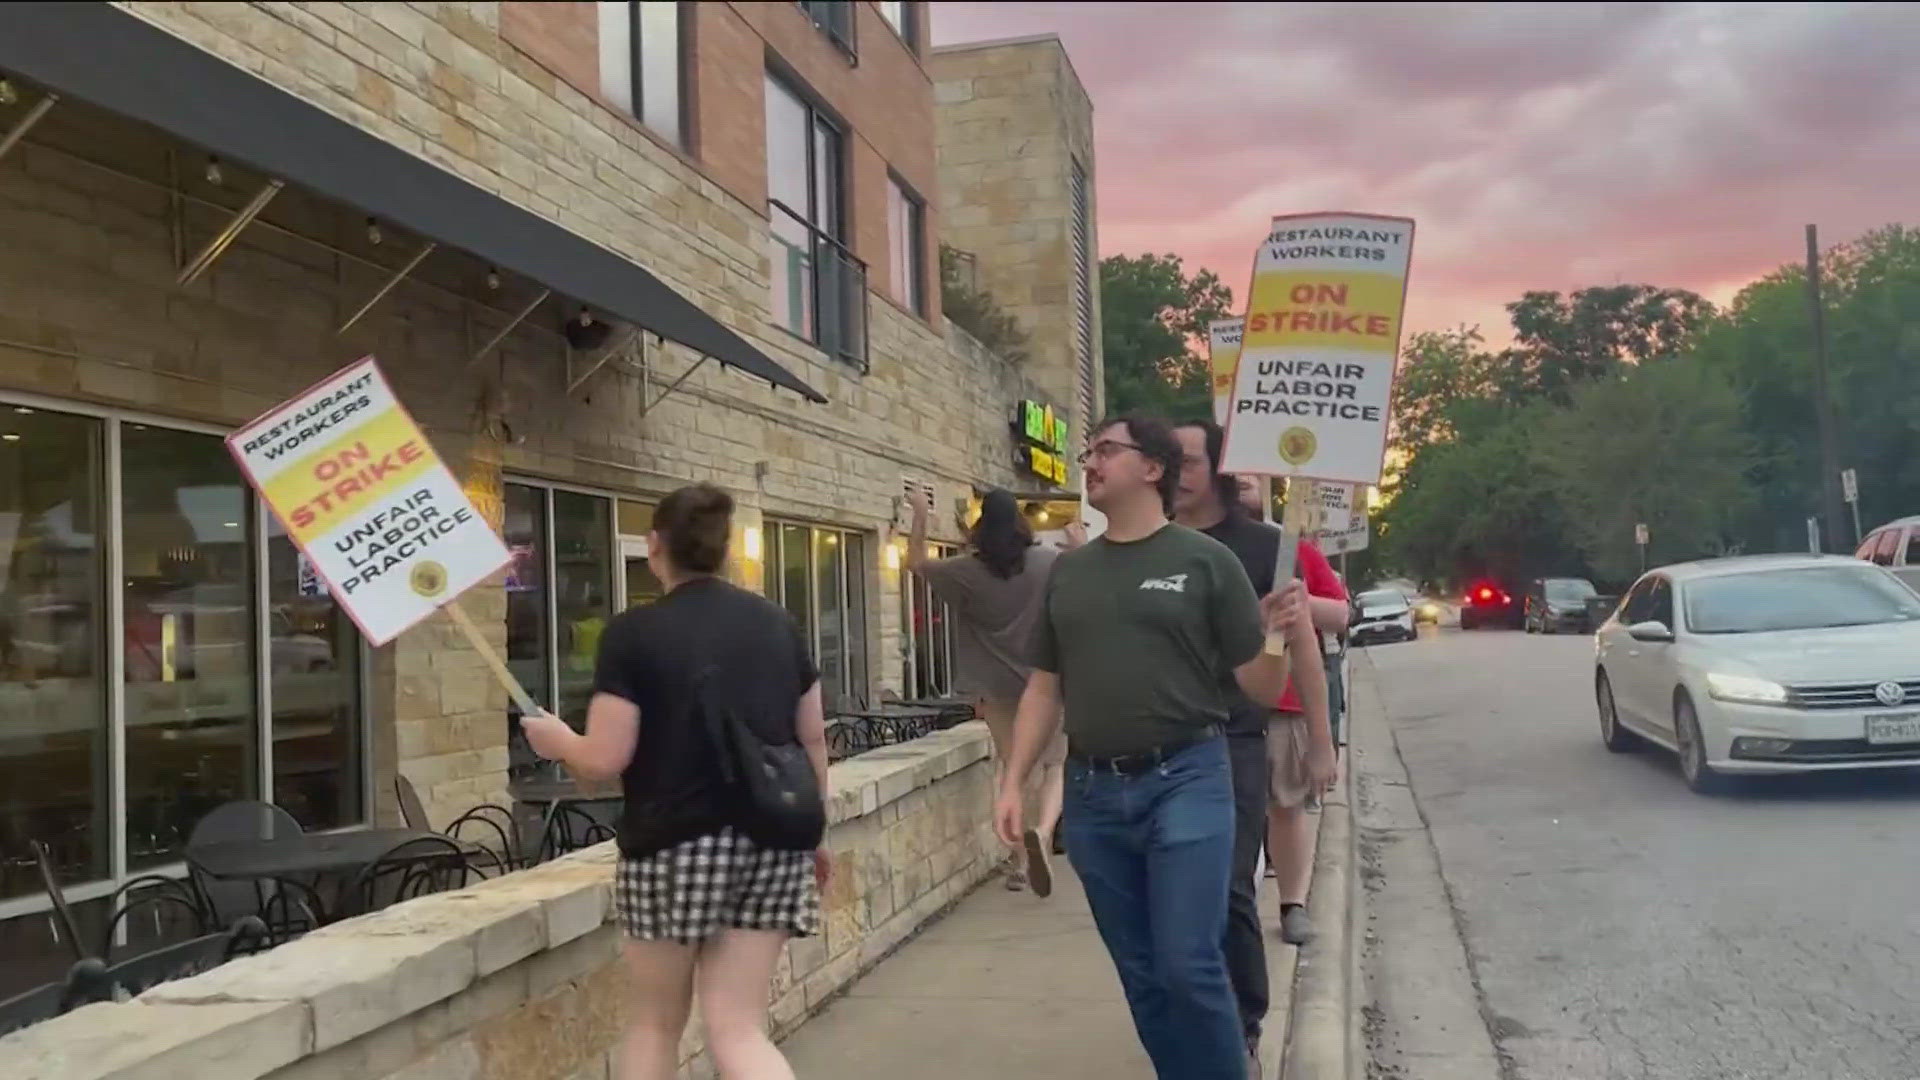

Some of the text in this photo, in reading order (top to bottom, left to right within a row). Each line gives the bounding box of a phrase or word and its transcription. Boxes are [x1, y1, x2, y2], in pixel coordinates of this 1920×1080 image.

[1272, 245, 1387, 261] WORKERS
[1290, 282, 1349, 306] ON
[1249, 311, 1391, 336] STRIKE
[1256, 380, 1357, 400] LABOR
[1258, 360, 1365, 380] UNFAIR
[243, 372, 373, 455] RESTAURANT
[264, 395, 371, 461] WORKERS
[1237, 400, 1380, 422] PRACTICE
[313, 441, 370, 482] ON
[290, 440, 424, 528] STRIKE
[334, 488, 433, 554] UNFAIR
[348, 506, 440, 569] LABOR
[341, 507, 472, 594] PRACTICE
